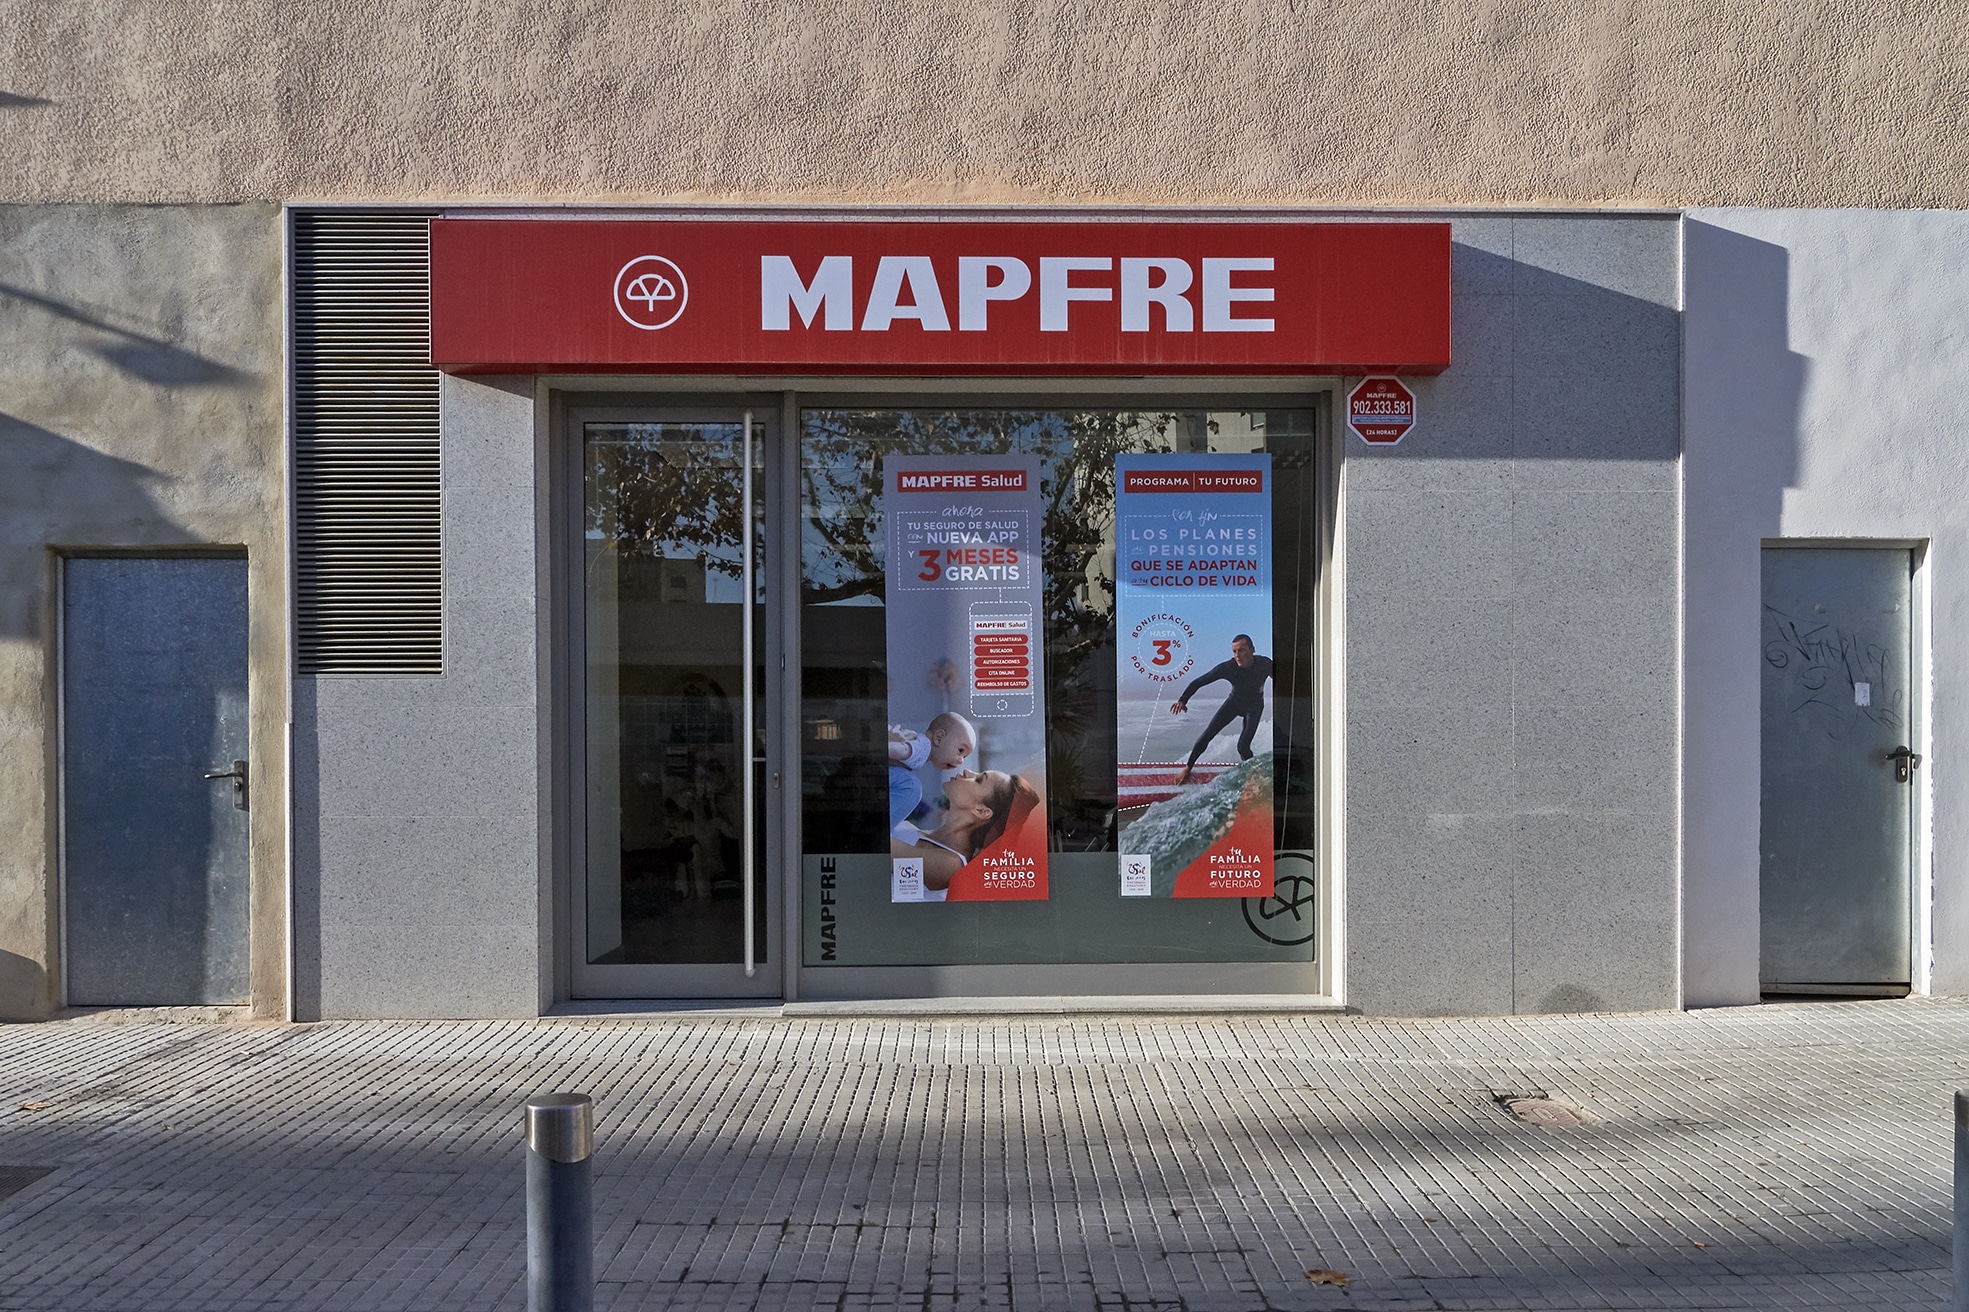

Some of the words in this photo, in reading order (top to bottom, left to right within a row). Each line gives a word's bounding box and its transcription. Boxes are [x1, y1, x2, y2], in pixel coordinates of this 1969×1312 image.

[761, 256, 1275, 332] MAPFRE
[1353, 401, 1411, 414] 902.333.581
[902, 475, 976, 488] MAPFRE
[981, 474, 1022, 487] Salud
[1130, 478, 1189, 486] PROGRAMA
[1215, 478, 1257, 486] FUTURO
[942, 505, 983, 518] ahora
[907, 522, 920, 530] TU
[924, 522, 966, 530] SEGURO
[985, 521, 1019, 529] SALUD
[927, 532, 983, 544] NUEVA
[988, 531, 1019, 543] APP
[1131, 529, 1168, 540] LOS
[1180, 529, 1257, 540] PLANES
[1149, 545, 1257, 556] PENSIONES
[946, 548, 1019, 565] MESES
[918, 550, 942, 582] 3
[1131, 560, 1161, 571] QUE
[1166, 560, 1183, 571] SE
[1188, 560, 1257, 571] ADAPTAN
[945, 566, 1020, 581] GRATIS
[1151, 576, 1194, 586] CICLO
[1199, 576, 1218, 586] DE
[1222, 576, 1257, 586] VIDA
[1132, 614, 1194, 638] BONIFICACIÓN
[1131, 656, 1145, 674] POR
[1003, 849, 1014, 858] tu
[1230, 847, 1241, 856] tu
[983, 858, 1034, 866] FAMILIA
[1210, 855, 1260, 864] FAMILIA
[984, 871, 1034, 880] SEGURO
[1211, 870, 1260, 878] FUTURO
[993, 880, 1035, 888] VERDAD
[1218, 880, 1261, 888] VERDAD
[821, 857, 836, 960] MAPFRE
